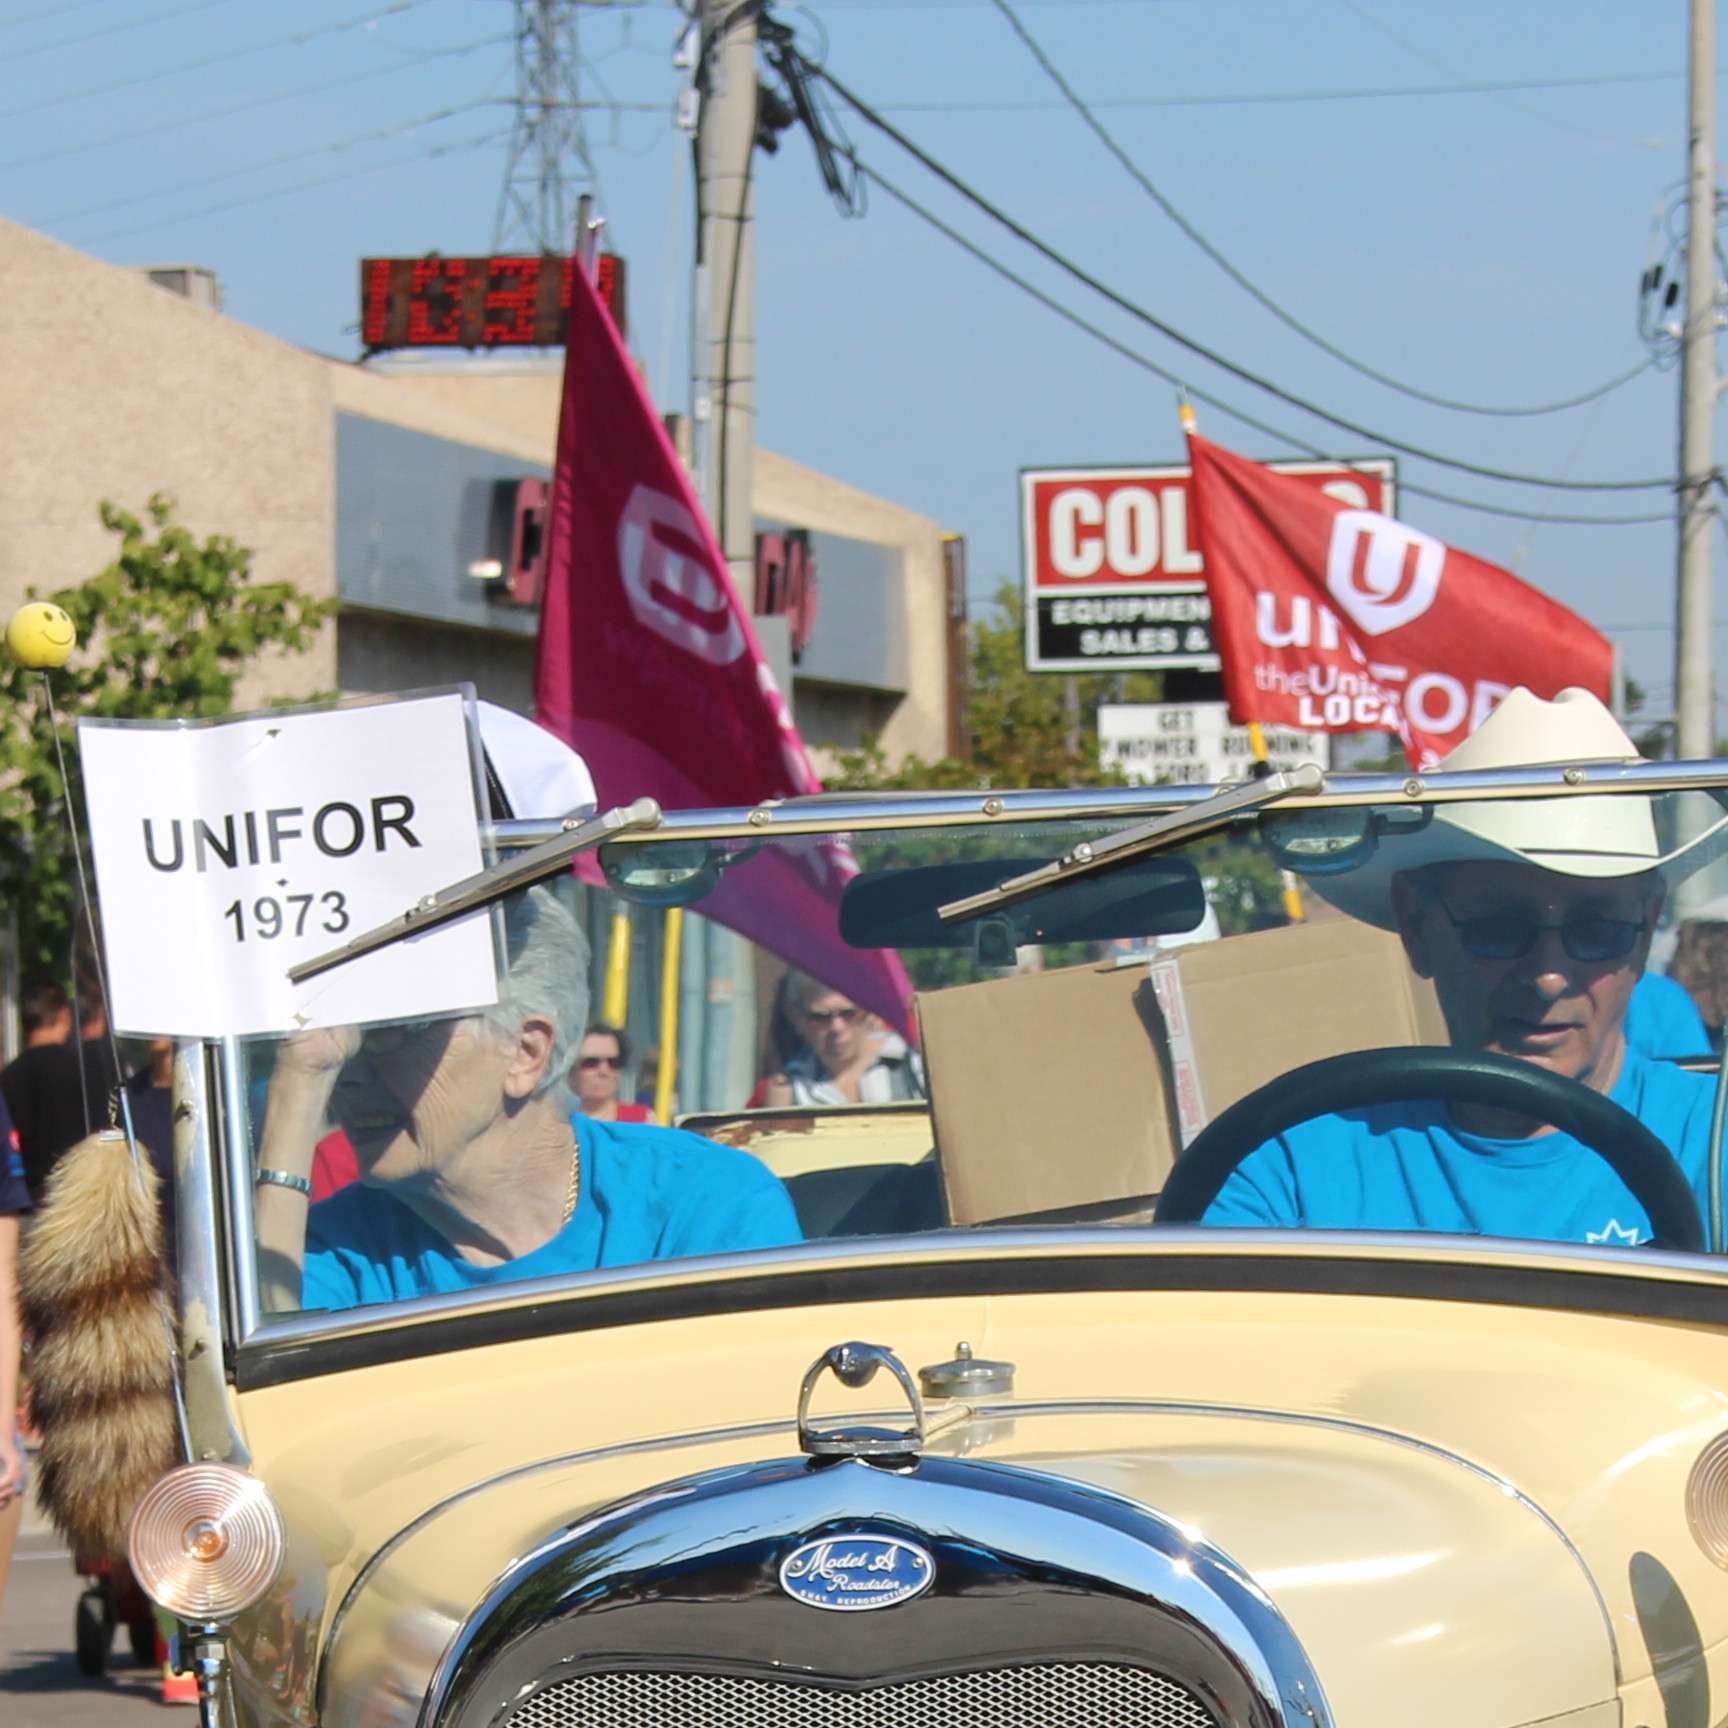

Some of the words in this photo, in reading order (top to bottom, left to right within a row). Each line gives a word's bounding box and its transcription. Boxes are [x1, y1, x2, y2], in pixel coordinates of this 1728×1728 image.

[1052, 596, 1211, 625] EQUIPMEN
[1080, 628, 1178, 656] SALES
[142, 795, 422, 873] UNIFOR
[224, 891, 350, 943] 1973
[787, 1543, 869, 1582] Model
[868, 1545, 900, 1572] A
[827, 1574, 901, 1592] Roadster
